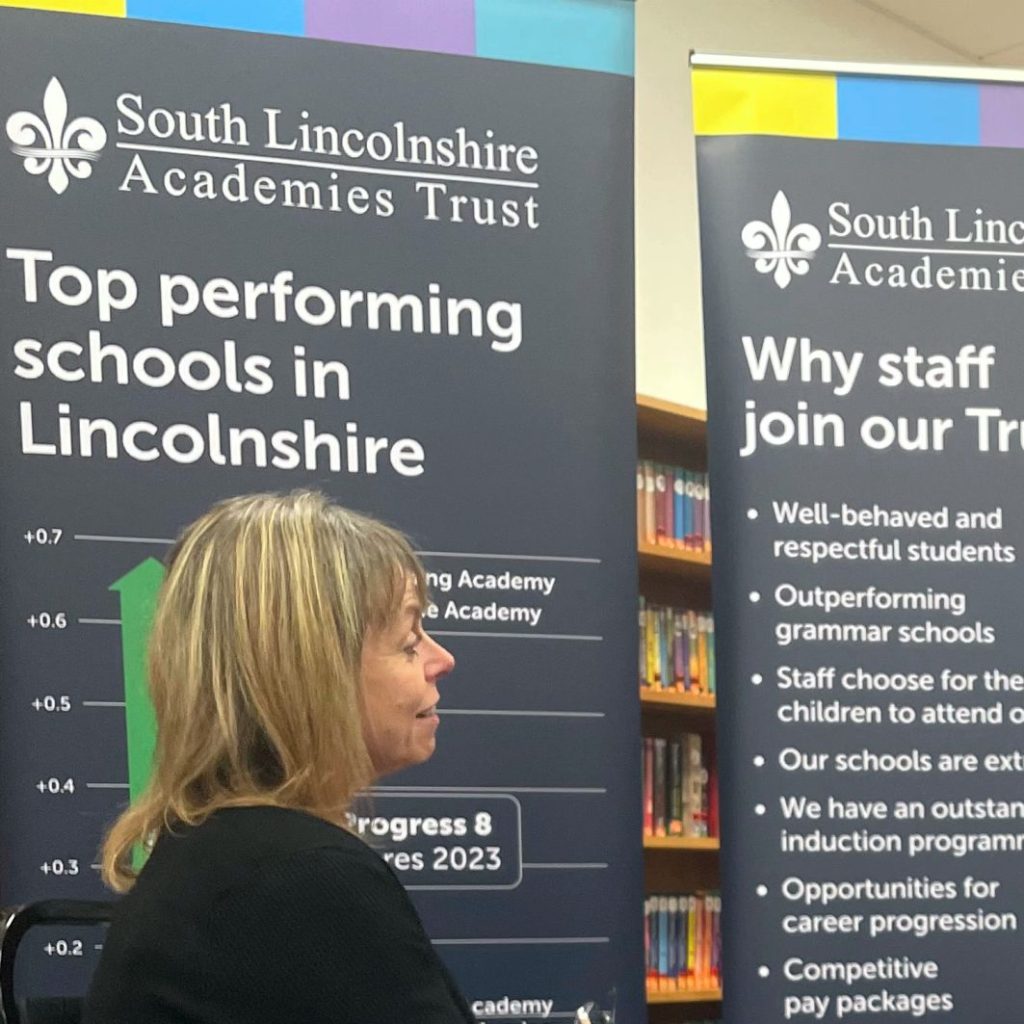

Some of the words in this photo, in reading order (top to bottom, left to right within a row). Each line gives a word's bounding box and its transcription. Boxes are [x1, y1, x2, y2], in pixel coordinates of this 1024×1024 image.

[116, 93, 250, 146] South
[263, 108, 538, 175] Lincolnshire
[118, 153, 394, 217] Academies
[415, 181, 539, 229] Trust
[828, 201, 934, 241] South
[6, 248, 138, 322] Top
[159, 270, 523, 353] performing
[13, 329, 274, 395] schools
[293, 345, 350, 400] in
[741, 335, 864, 396] Why
[878, 344, 996, 389] staff
[19, 401, 425, 477] Lincolnshire
[739, 399, 845, 457] join
[860, 415, 954, 451] our
[772, 501, 949, 529] Well-behaved
[955, 507, 1003, 530] and
[24, 528, 63, 545] +0.7
[773, 538, 902, 564] respectful
[907, 540, 1016, 563] students
[457, 569, 556, 596] Academy
[774, 583, 966, 616] Outperforming
[27, 612, 67, 629] +0.6
[444, 600, 542, 626] Academy
[775, 622, 893, 646] grammar
[898, 621, 996, 644] schools
[776, 665, 836, 689] Staff
[841, 668, 935, 691] choose
[940, 668, 978, 692] for
[32, 695, 71, 712] +0.5
[777, 699, 882, 724] children
[888, 703, 916, 724] to
[921, 702, 1003, 724] attend
[778, 747, 829, 771] Our
[835, 749, 933, 772] schools
[937, 754, 979, 772] are
[36, 777, 75, 794] +0.4
[779, 796, 822, 819] We
[828, 796, 888, 820] have
[893, 801, 925, 820] an
[474, 812, 492, 836] 8
[781, 829, 902, 852] induction
[40, 859, 79, 875] +0.3
[382, 850, 424, 871] res
[432, 846, 502, 871] 2023
[781, 876, 957, 905] Opportunities
[963, 876, 1000, 899] for
[782, 914, 864, 933] career
[869, 908, 1017, 937] progression
[44, 939, 83, 956] +0.2
[783, 956, 939, 985] Competitive
[472, 995, 553, 1018] cademy
[784, 995, 830, 1019] pay
[836, 989, 954, 1018] packages
